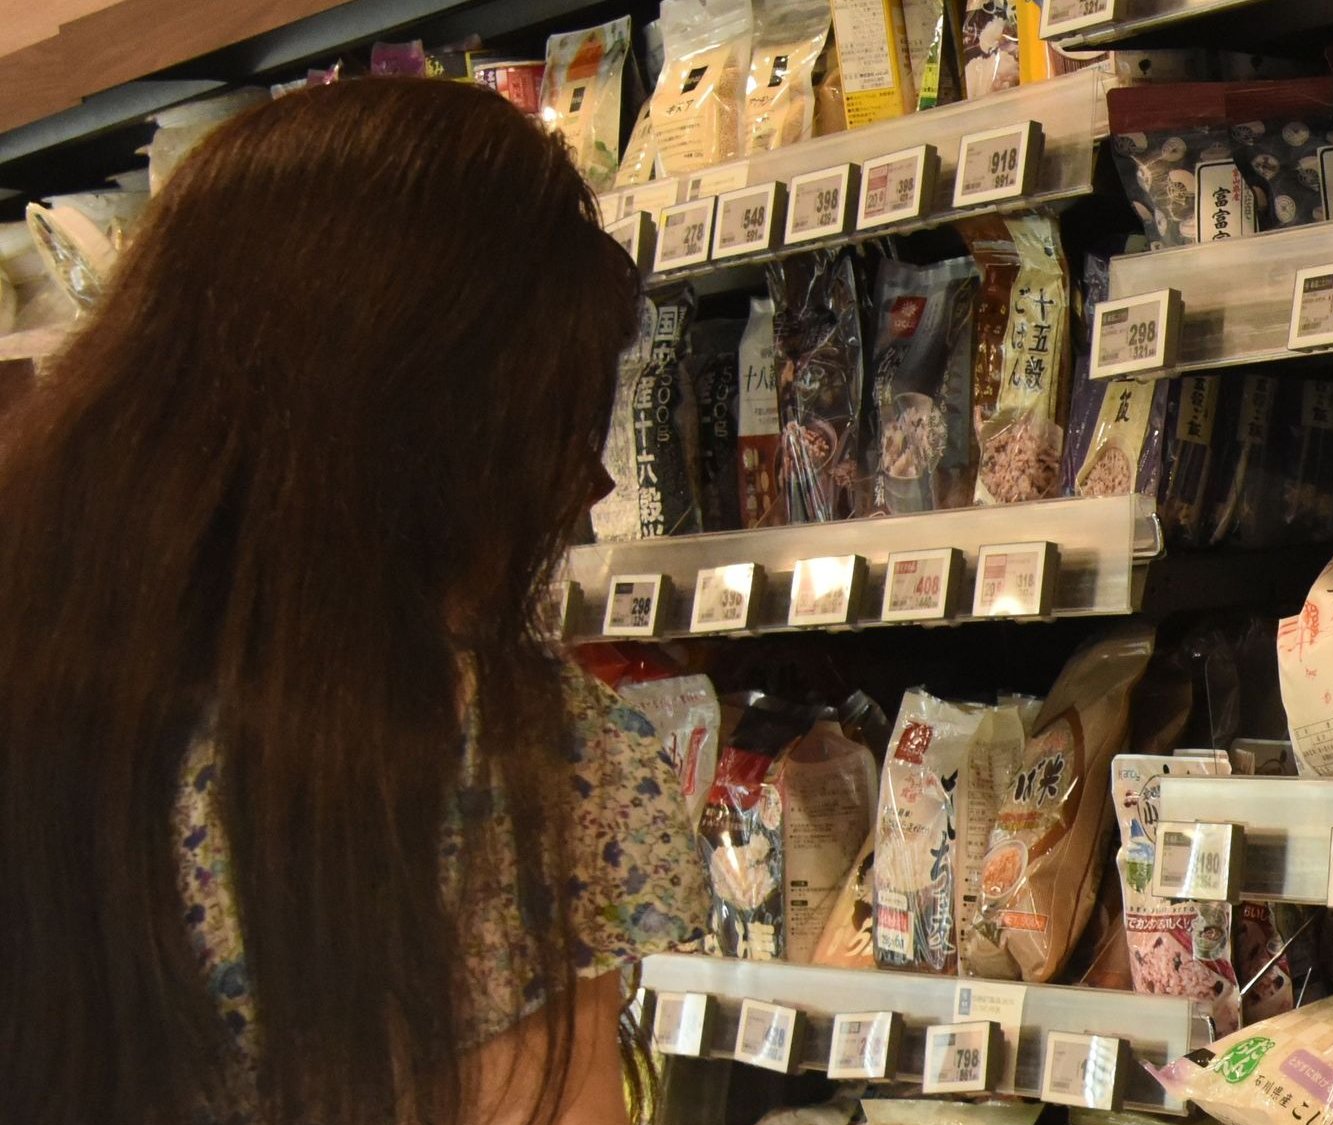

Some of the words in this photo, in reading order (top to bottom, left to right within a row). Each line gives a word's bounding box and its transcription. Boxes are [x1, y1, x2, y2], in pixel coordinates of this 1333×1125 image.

[990, 148, 1018, 176] 918
[816, 188, 839, 213] 398
[744, 206, 765, 230] 548
[1024, 288, 1054, 391] 十五穀
[1129, 320, 1156, 346] 298
[913, 576, 940, 597] 408
[957, 1049, 979, 1068] 798
[1254, 1073, 1295, 1109] 石川県産
